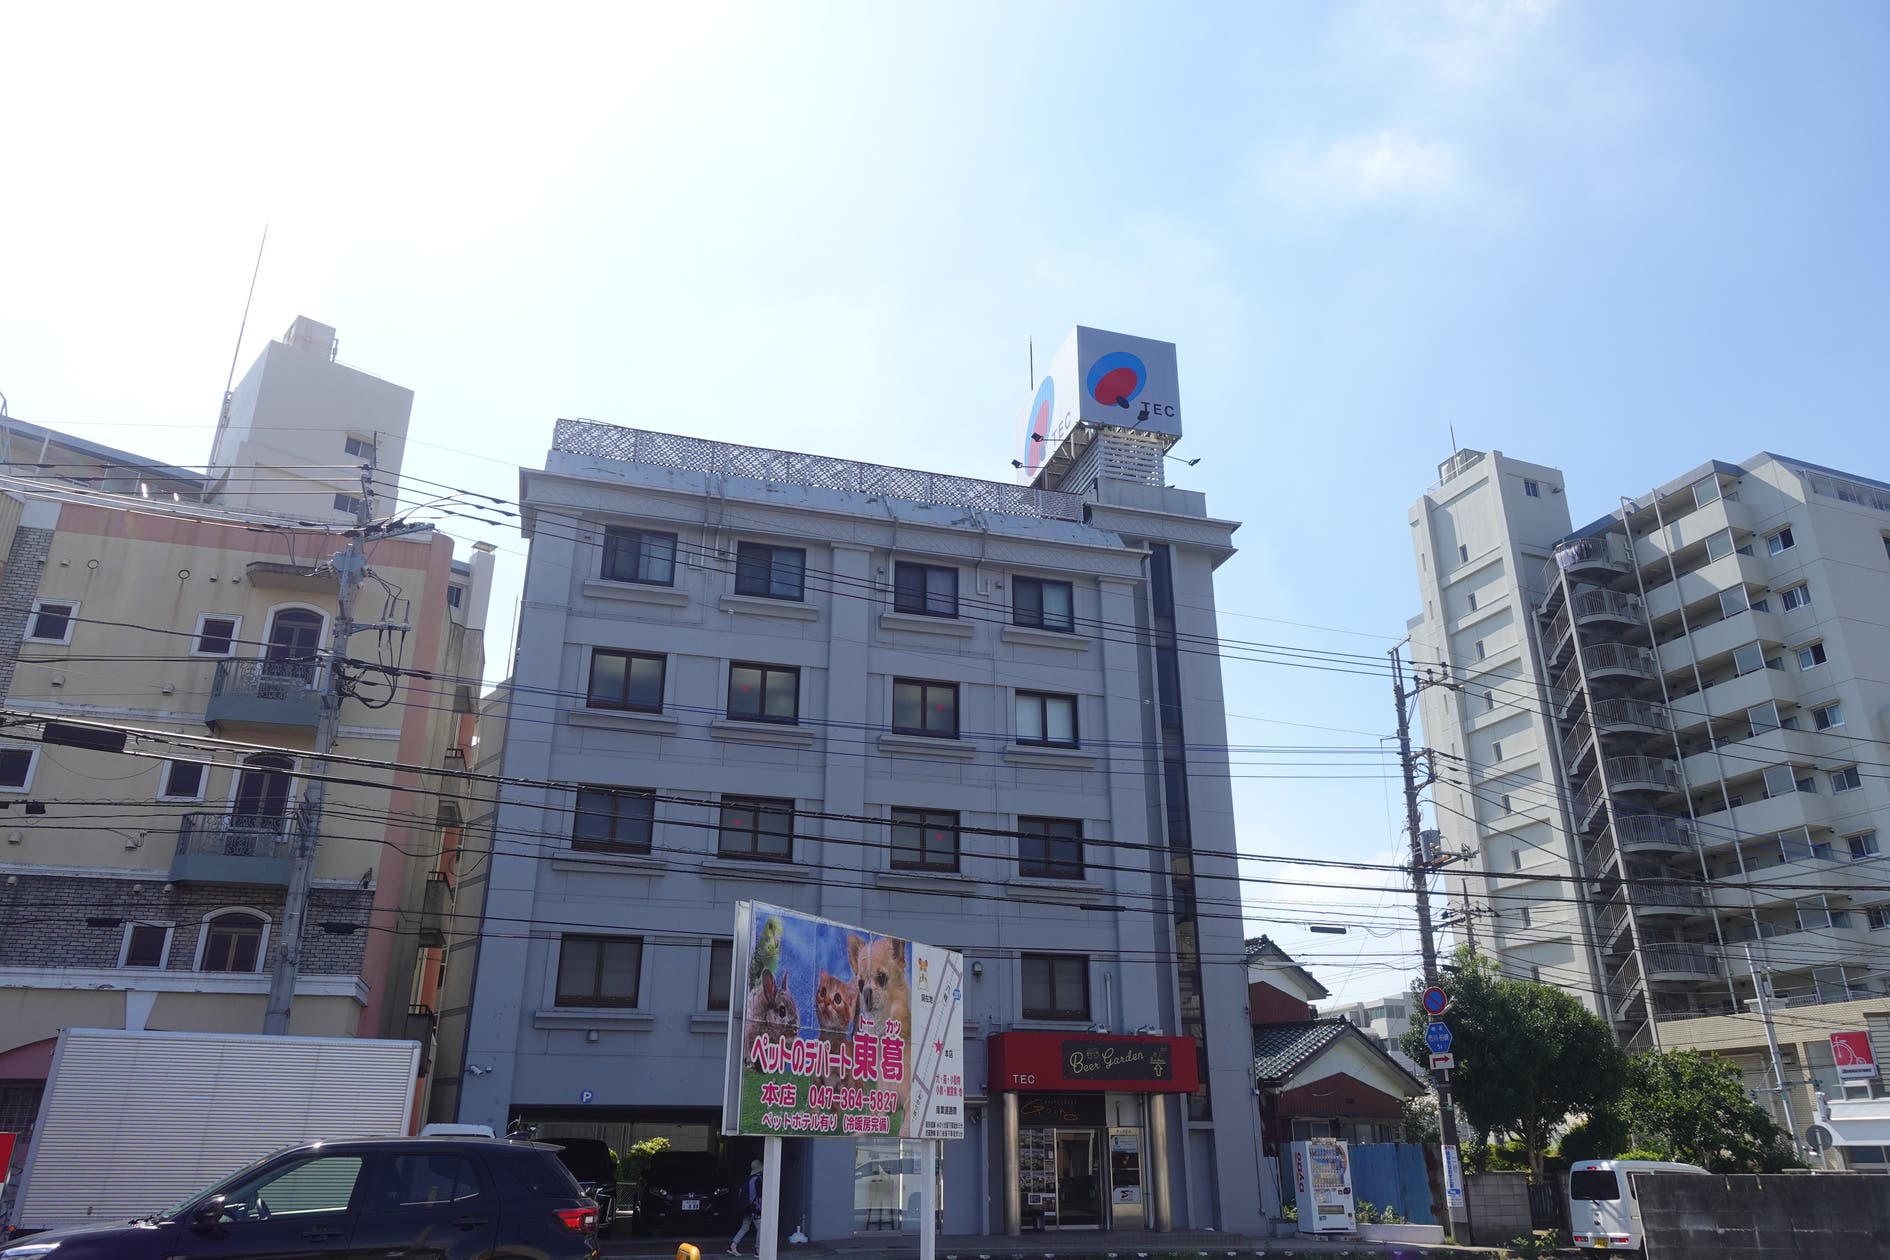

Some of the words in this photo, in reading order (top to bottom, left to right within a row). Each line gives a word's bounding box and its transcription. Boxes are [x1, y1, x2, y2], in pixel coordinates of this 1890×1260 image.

[1141, 401, 1175, 417] TEC
[1051, 411, 1071, 445] TEC
[1070, 1052, 1100, 1074] Beer
[1102, 1048, 1144, 1070] Garden
[1013, 1074, 1036, 1085] TEC
[583, 1092, 592, 1102] P
[761, 1083, 796, 1106] 本店
[808, 1085, 898, 1112] 047-364-5827
[762, 1112, 837, 1130] ペットホテル有り
[843, 1115, 890, 1133] (冷暖房完備)
